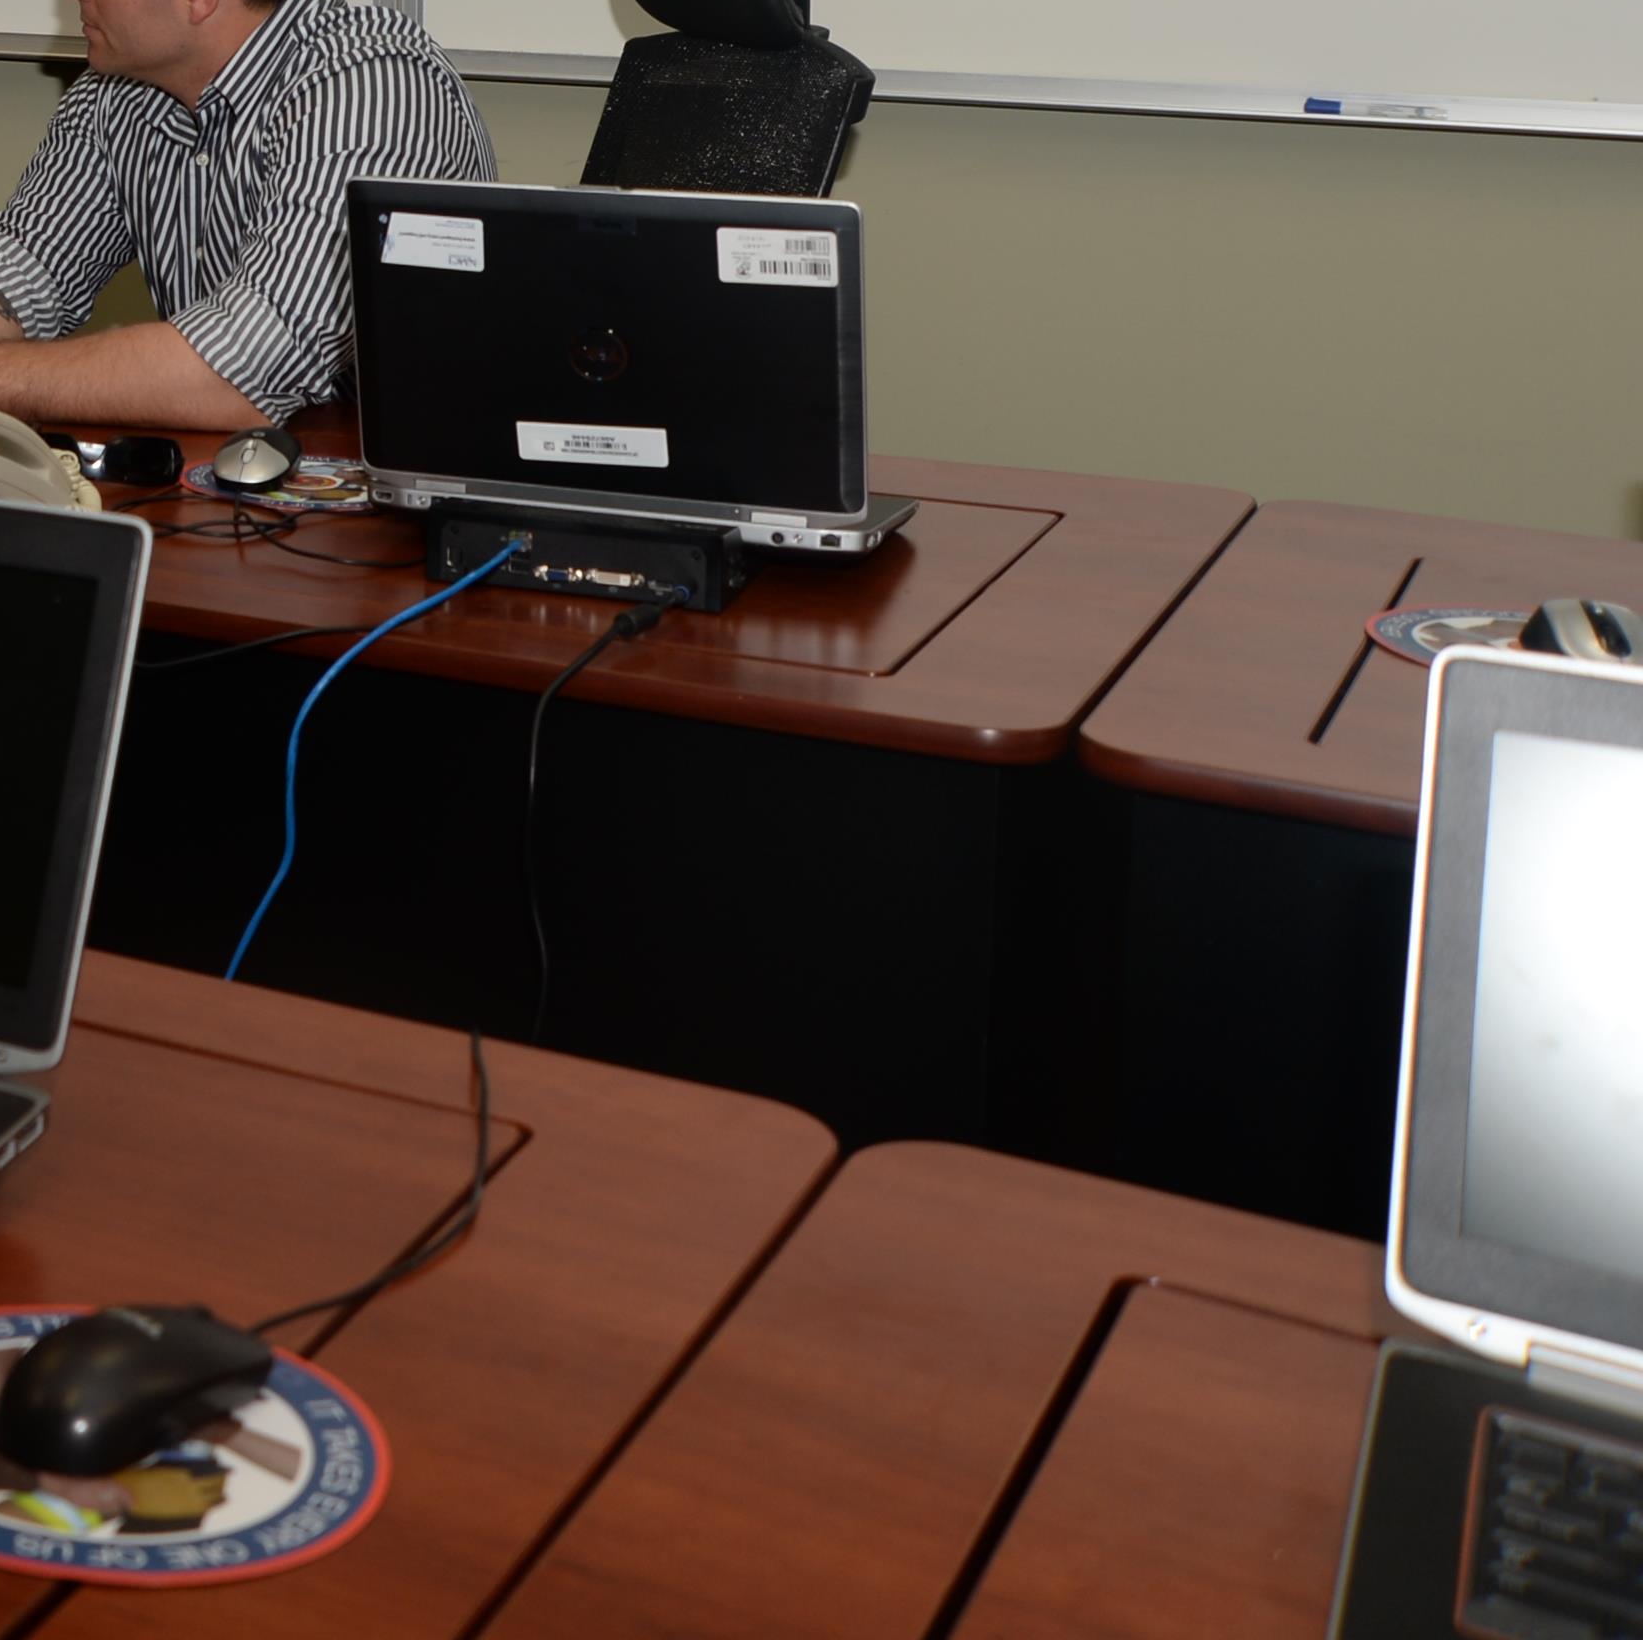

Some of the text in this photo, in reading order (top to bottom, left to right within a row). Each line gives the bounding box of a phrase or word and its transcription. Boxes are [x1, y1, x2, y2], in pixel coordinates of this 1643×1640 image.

[13, 1533, 75, 1562] US
[87, 1543, 150, 1571] OF
[158, 1538, 251, 1569] ONE
